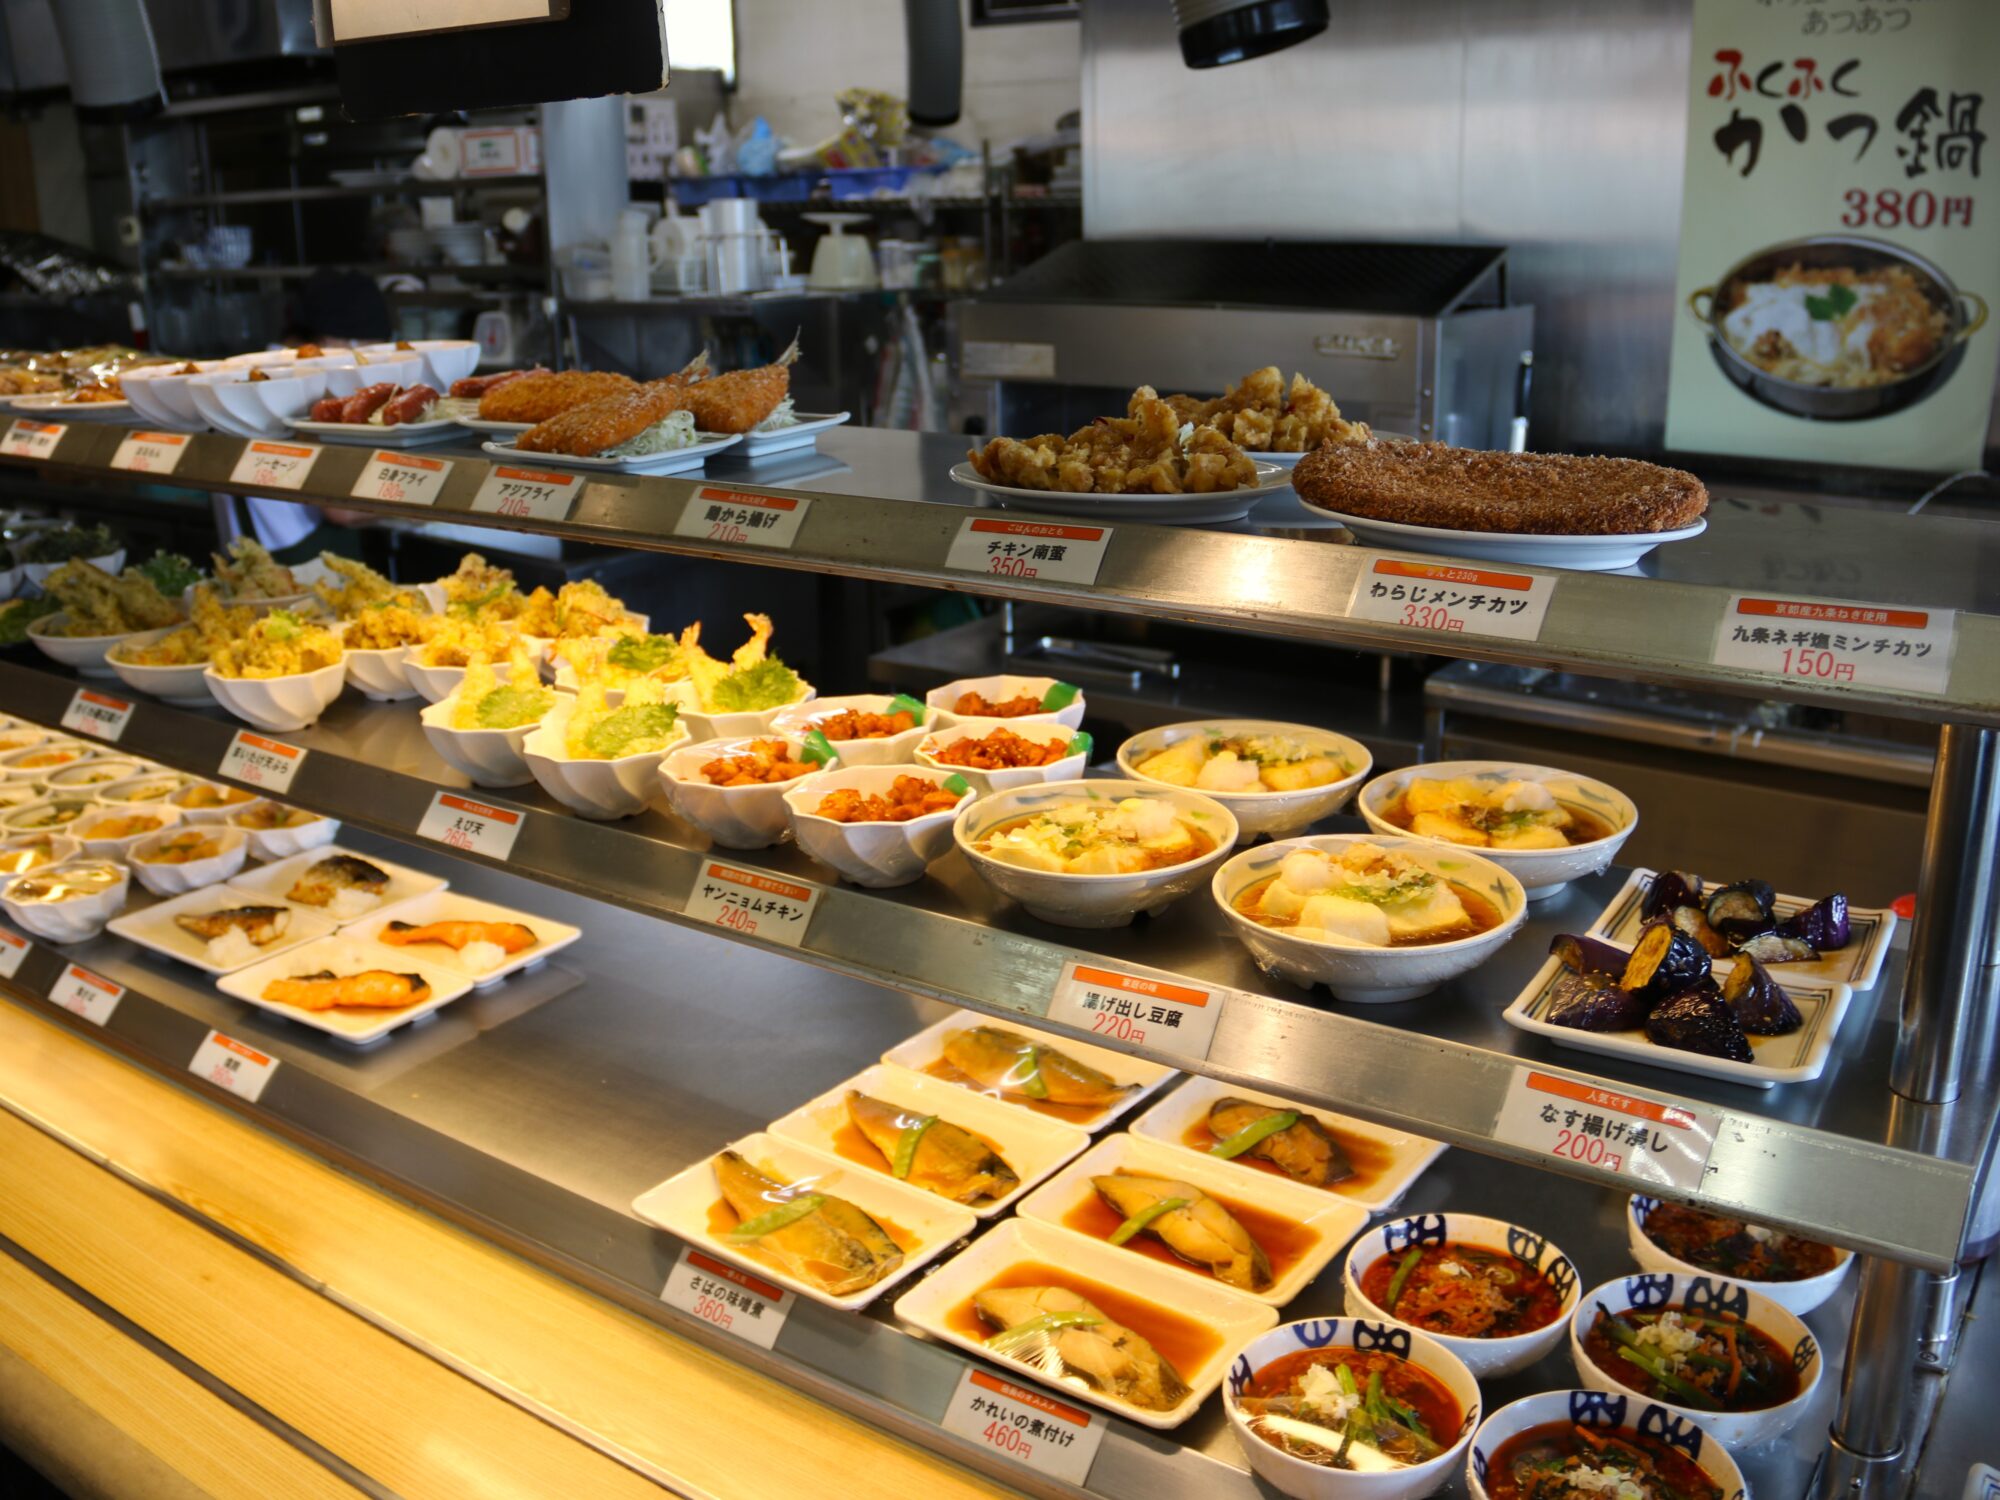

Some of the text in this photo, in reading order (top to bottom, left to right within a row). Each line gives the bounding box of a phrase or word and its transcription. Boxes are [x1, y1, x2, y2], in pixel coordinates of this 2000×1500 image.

[1707, 48, 1861, 101] ふくふく
[1713, 86, 1988, 179] かつ鍋
[1841, 188, 1975, 230] 380円
[498, 483, 556, 502] アジフライ
[704, 504, 781, 530] 鶏から揚げ
[708, 522, 748, 543] 210円
[1007, 523, 1064, 536] ごはんのおとも
[986, 541, 1068, 562] チキン南蛮
[988, 556, 1038, 578] 350円
[1370, 581, 1529, 615] わらじメンチカツ
[1775, 603, 1889, 623] 京都産九条ねぎ使用
[1399, 603, 1464, 632] 330円
[1732, 625, 1932, 658] 九条ネギ塩ミンチカツ
[1781, 648, 1855, 681] 150円
[453, 816, 486, 836] えび天
[703, 884, 804, 921] ヤンニョムチキン
[716, 904, 758, 934] 240円
[1121, 977, 1158, 993] 家庭の味
[1082, 991, 1184, 1028] 揚げ出し豆腐
[1091, 1012, 1146, 1044] 220円
[1586, 1090, 1633, 1109] 人気です
[1552, 1129, 1622, 1172] 200円
[690, 1275, 766, 1320] さばの味噌煮
[693, 1294, 734, 1330] 360円
[970, 1396, 1075, 1448] かれいの煮付け
[983, 1420, 1033, 1460] 460円
